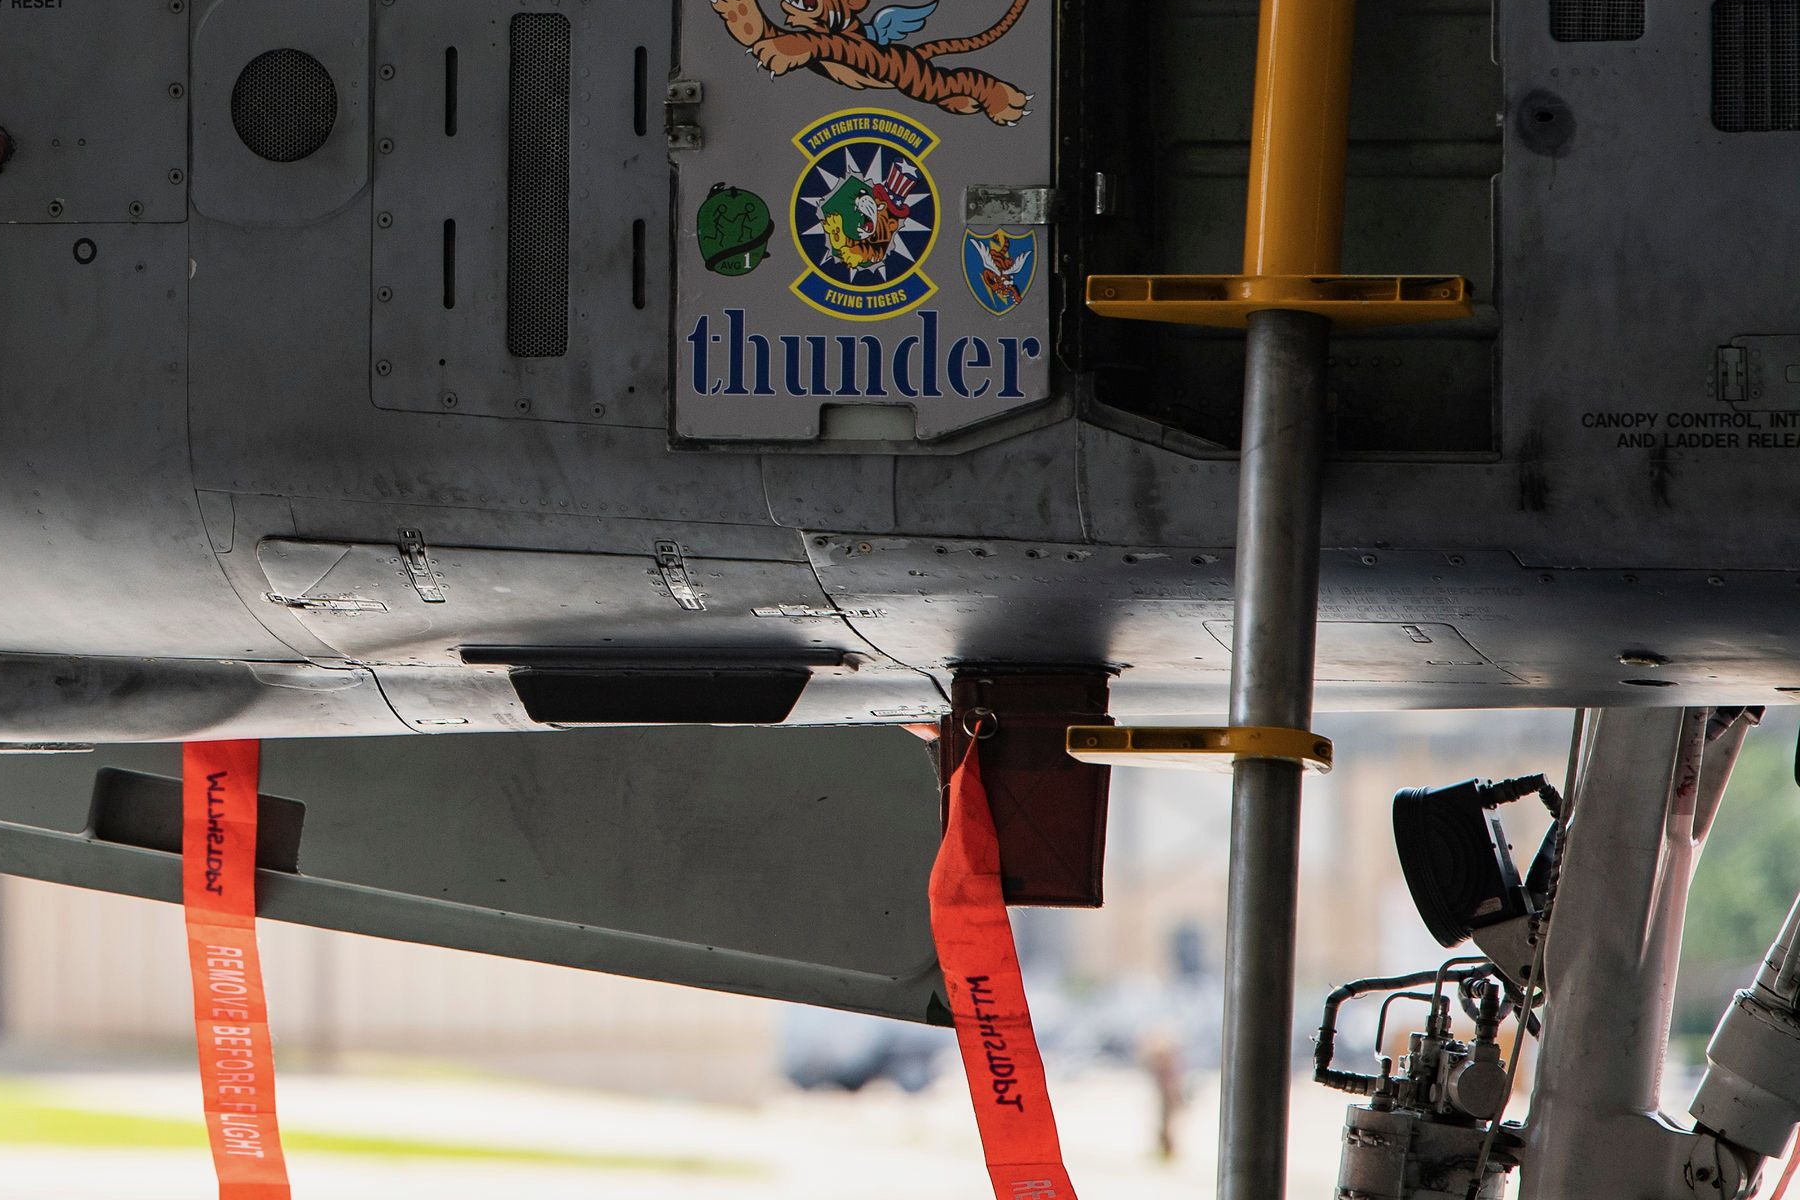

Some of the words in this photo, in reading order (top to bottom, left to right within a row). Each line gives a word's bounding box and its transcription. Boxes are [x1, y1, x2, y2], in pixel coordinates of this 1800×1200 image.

[807, 128, 831, 150] 74TH
[831, 118, 870, 137] FIGHTER
[872, 118, 923, 149] SQUADRON
[743, 252, 752, 269] 1
[825, 289, 864, 309] FLYING
[866, 288, 907, 309] TIGERS
[687, 309, 1042, 398] thunder
[1581, 412, 1658, 428] CANOPY
[1666, 412, 1762, 430] CONTROL,
[1616, 433, 1656, 448] AND
[1664, 433, 1739, 448] LADDER
[1749, 433, 1800, 448] RELE
[206, 944, 249, 1020] REMOVE
[213, 1024, 257, 1096] BEFORE
[218, 1102, 264, 1159] FLIGHT
